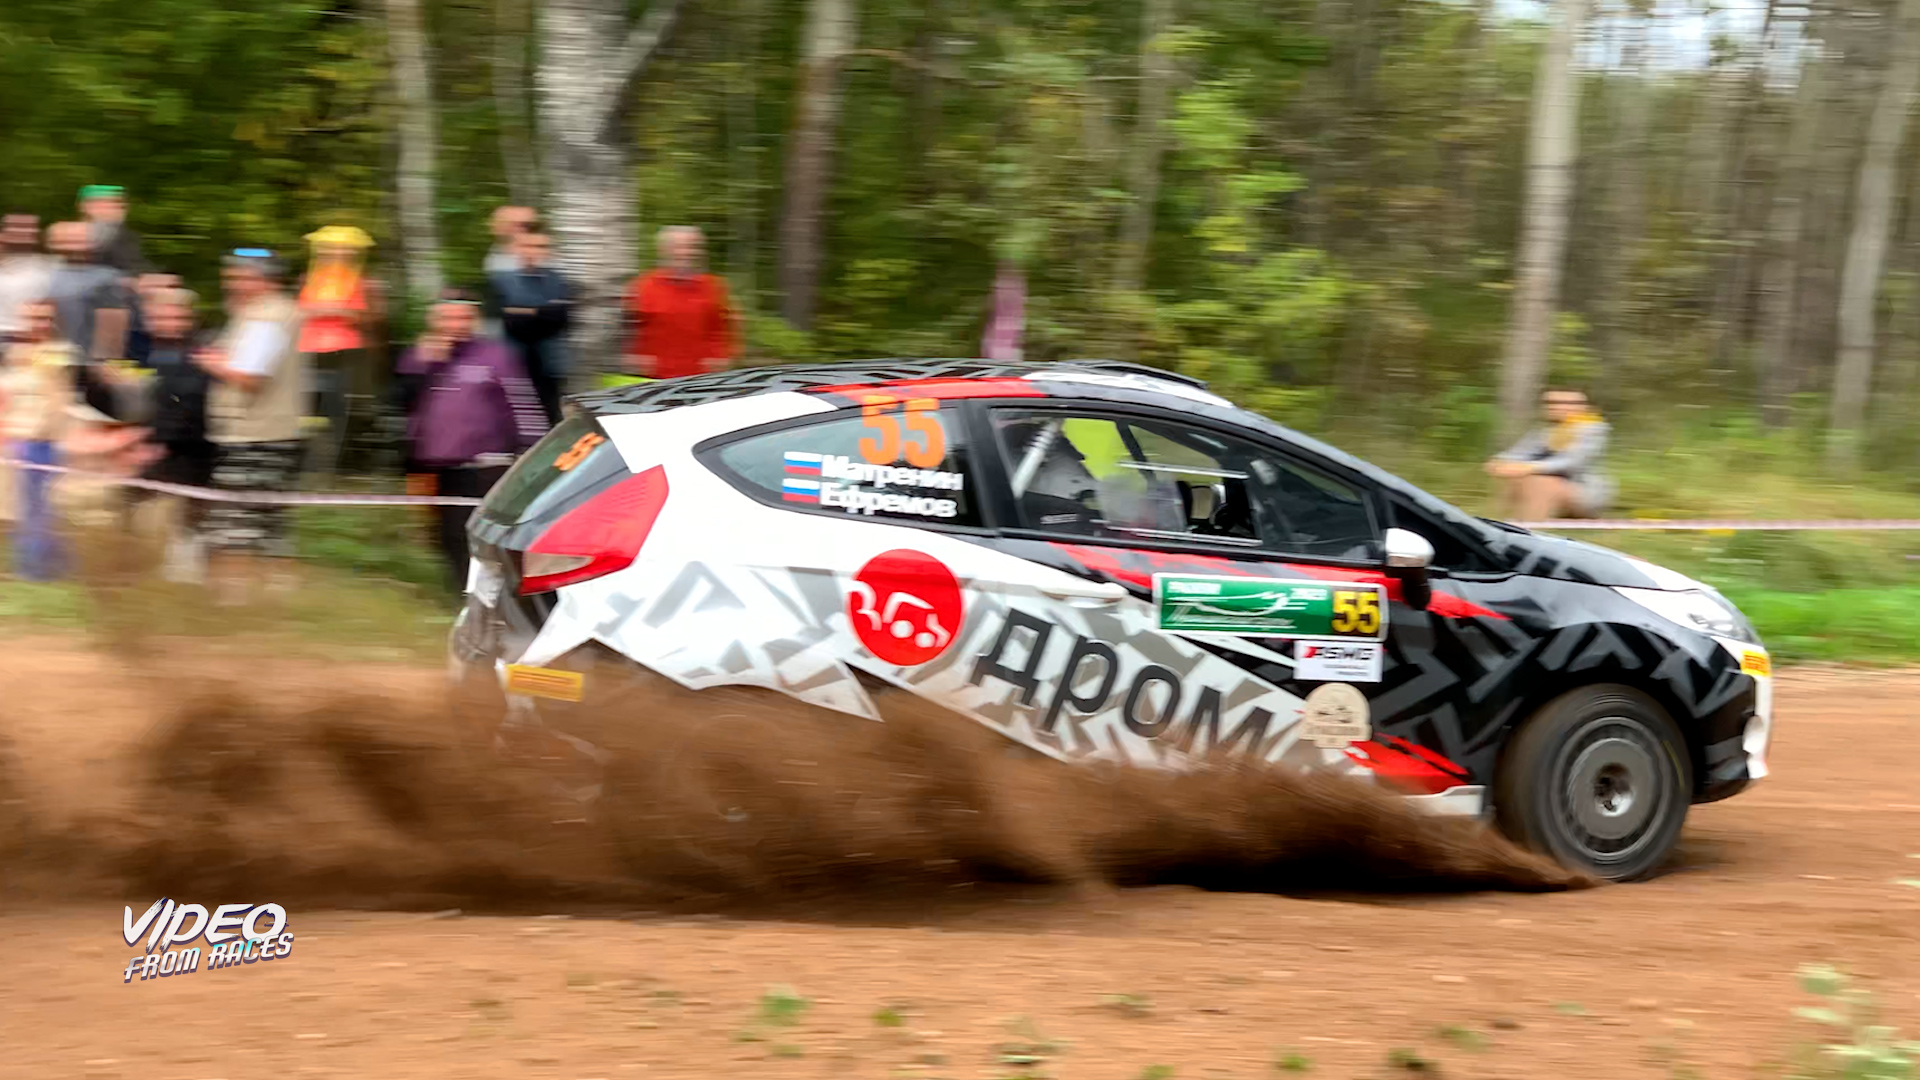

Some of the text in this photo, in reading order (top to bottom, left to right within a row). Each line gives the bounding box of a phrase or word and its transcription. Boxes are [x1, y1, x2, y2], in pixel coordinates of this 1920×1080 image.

[859, 396, 945, 467] 55
[821, 455, 963, 490] Матренин
[820, 482, 957, 517] Ефремов
[1331, 591, 1380, 634] 55
